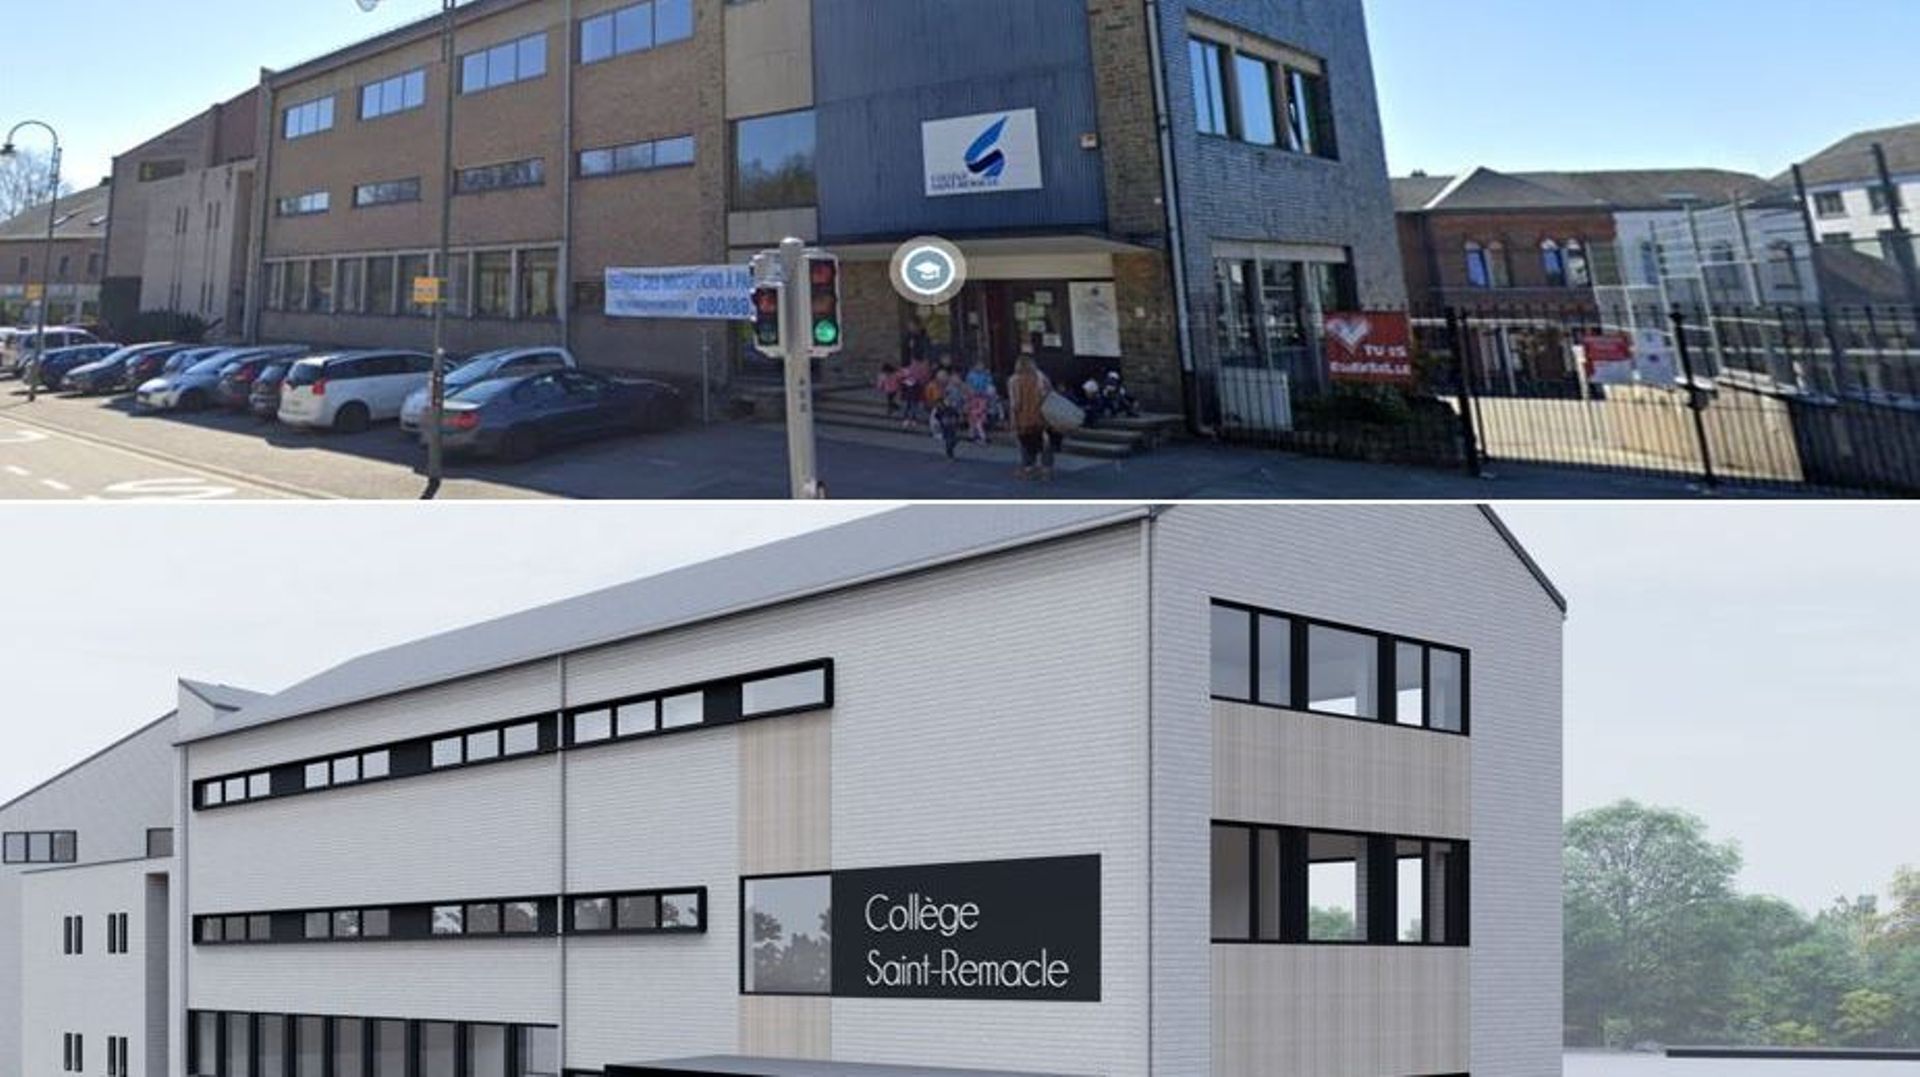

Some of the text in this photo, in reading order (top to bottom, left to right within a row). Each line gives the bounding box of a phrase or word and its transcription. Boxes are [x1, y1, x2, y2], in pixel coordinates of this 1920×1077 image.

[1363, 344, 1385, 356] TU
[865, 892, 980, 937] Collège
[866, 947, 1070, 988] Saint-Remacle
